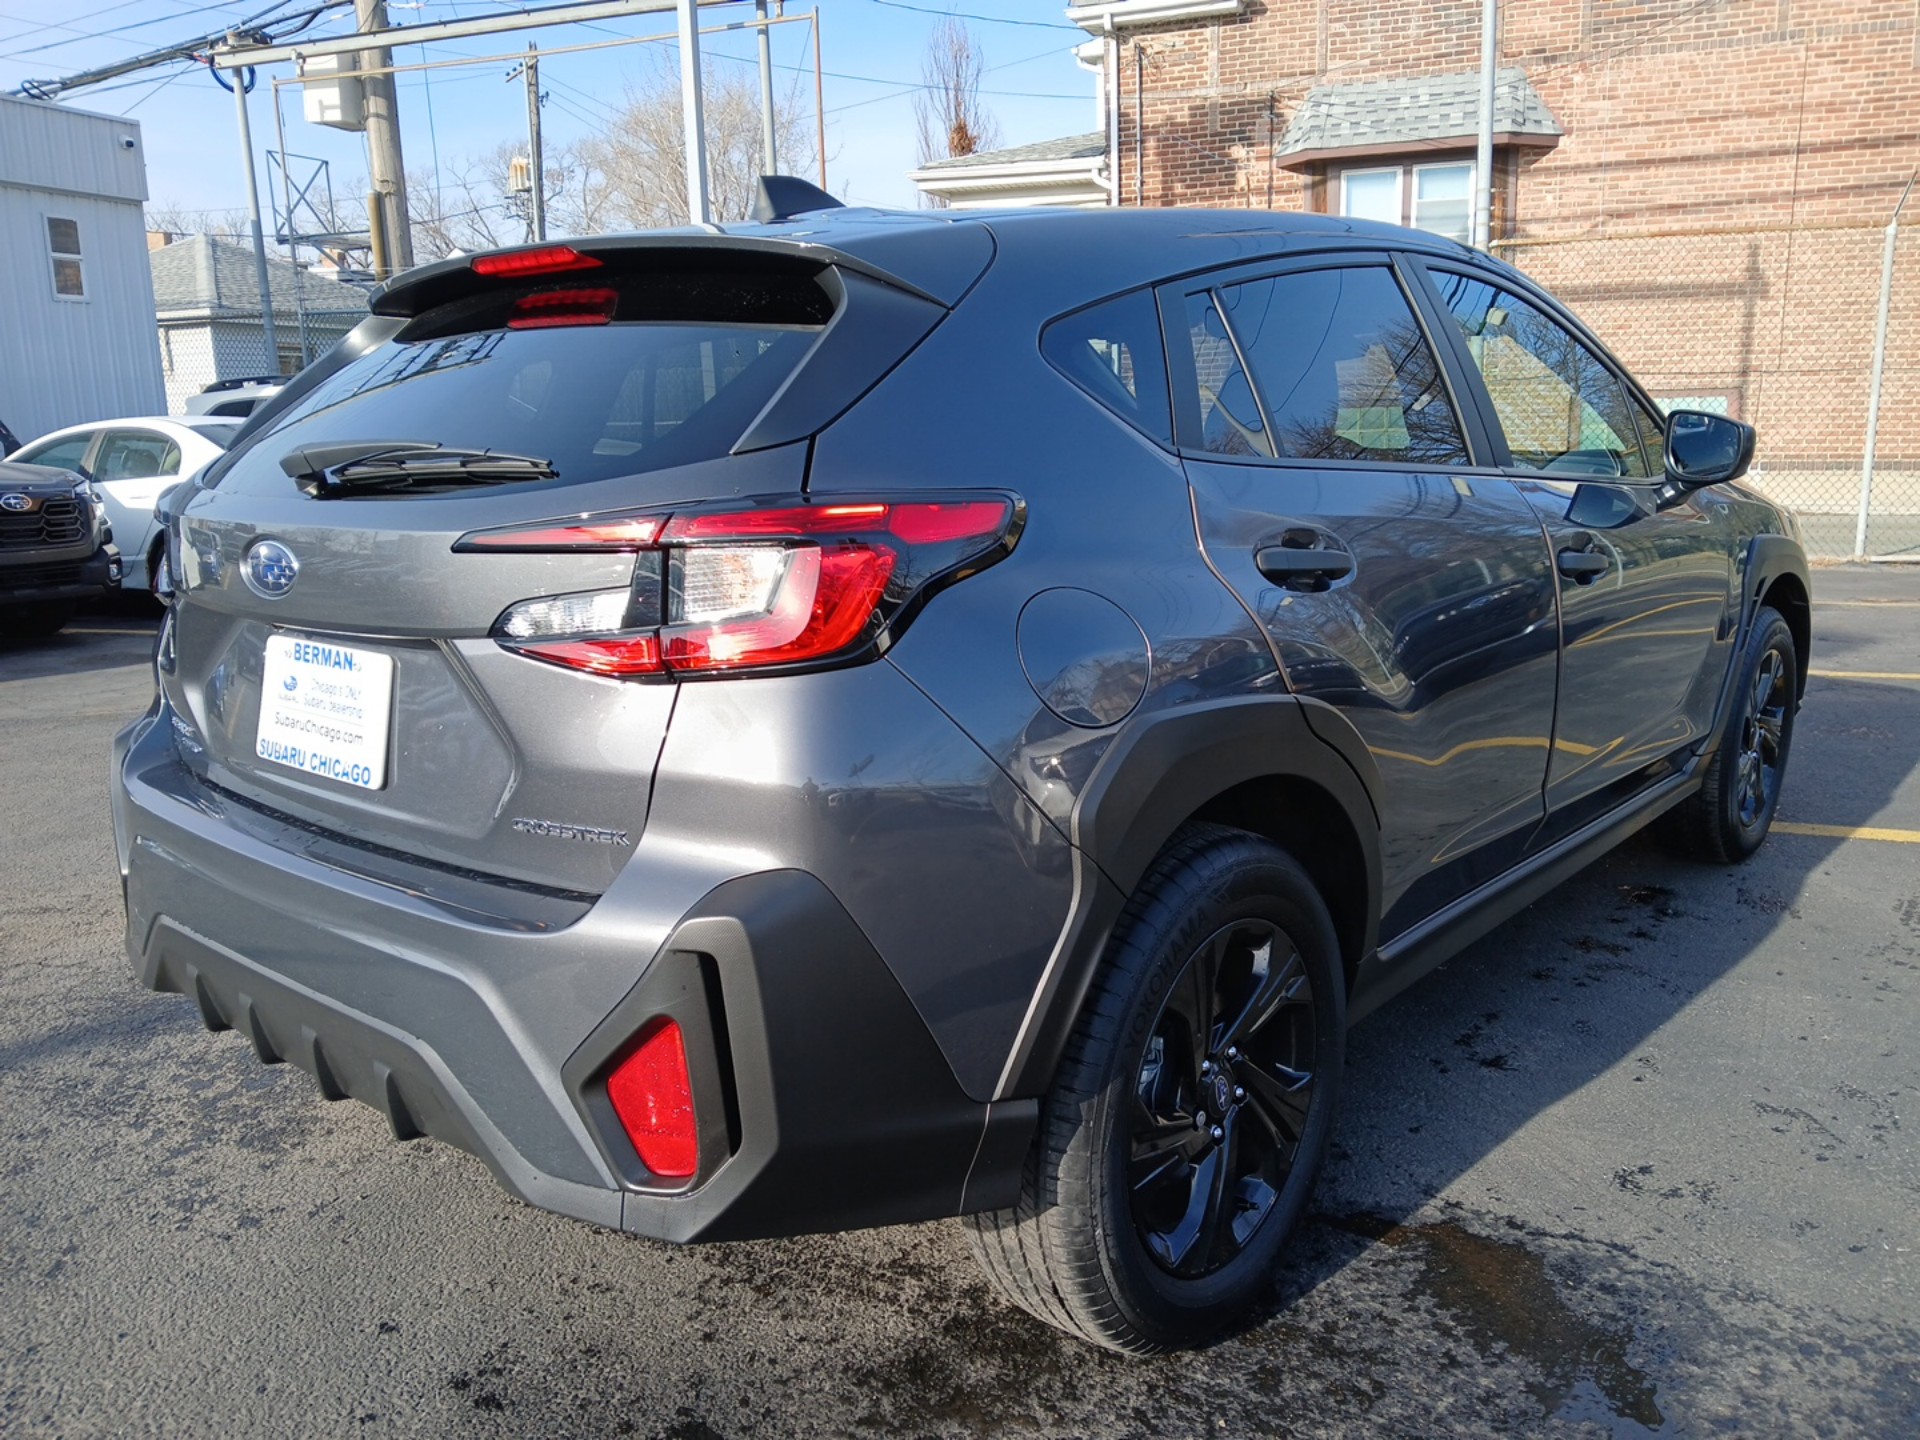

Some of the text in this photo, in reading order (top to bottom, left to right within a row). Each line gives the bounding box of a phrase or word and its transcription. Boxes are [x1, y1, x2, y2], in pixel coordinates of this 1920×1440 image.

[294, 642, 353, 671] BERMAN
[274, 711, 364, 745] SubaruChicago.com
[259, 738, 371, 785] SUBARU CHICAGO
[1125, 905, 1208, 1050] YOKOHAMA
